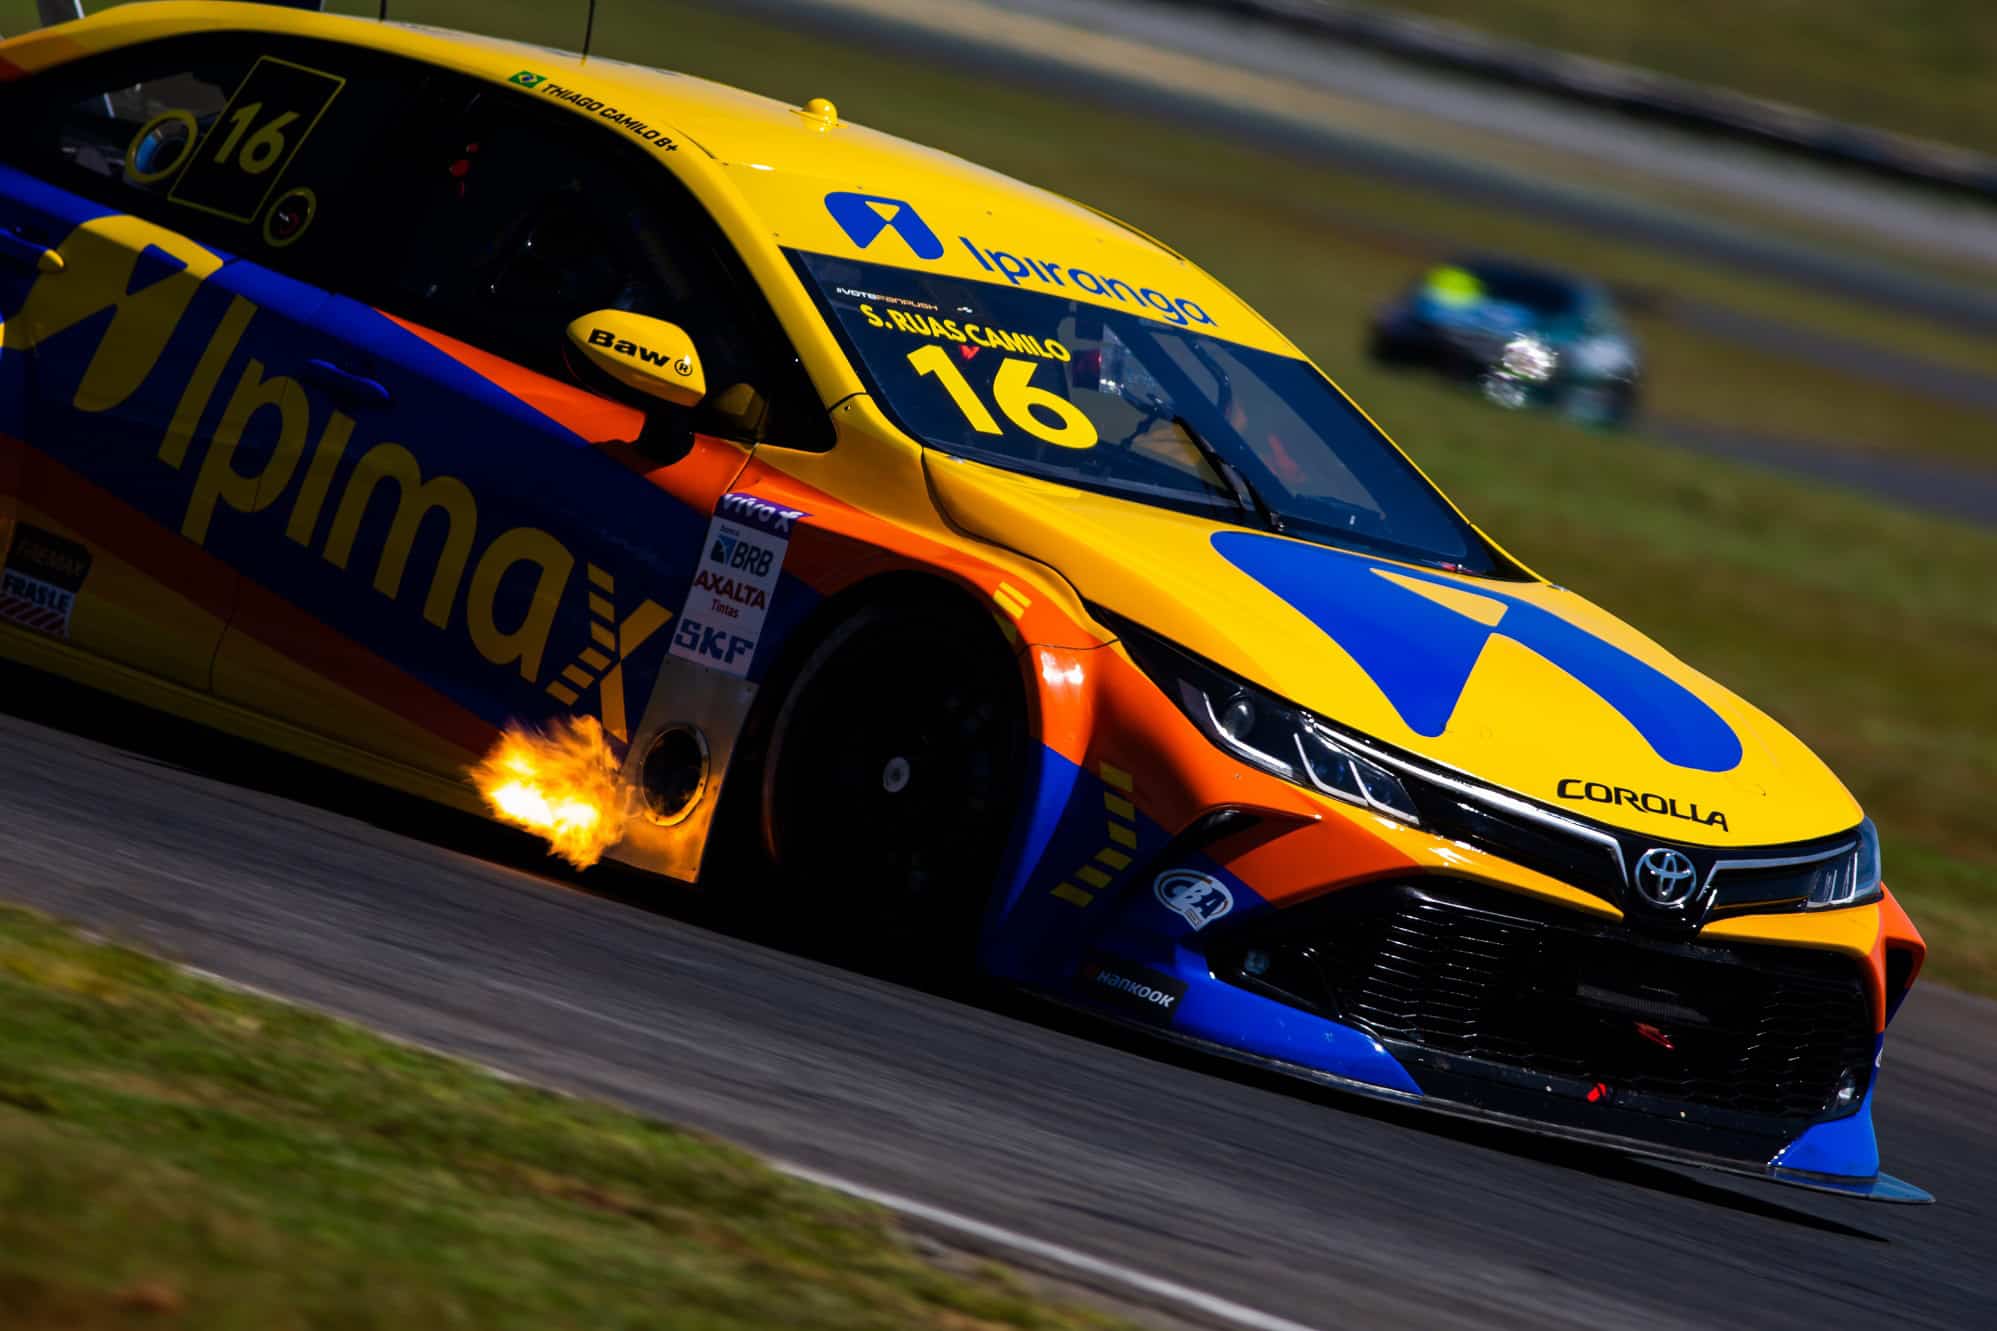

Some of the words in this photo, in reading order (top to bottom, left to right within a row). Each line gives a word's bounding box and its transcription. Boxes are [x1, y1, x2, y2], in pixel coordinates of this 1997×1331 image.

[212, 100, 304, 175] 16
[542, 83, 605, 112] THIAGO
[600, 107, 660, 140] CAMILO
[653, 137, 679, 152] B+
[958, 235, 1219, 328] Ipiranga
[964, 323, 1072, 363] CAMILO
[906, 343, 1099, 450] 16
[157, 294, 673, 745] Ipimax
[694, 570, 766, 610] AXALTA
[731, 541, 774, 578] BRB
[674, 619, 755, 664] SKF
[1556, 779, 1729, 833] COROLLA
